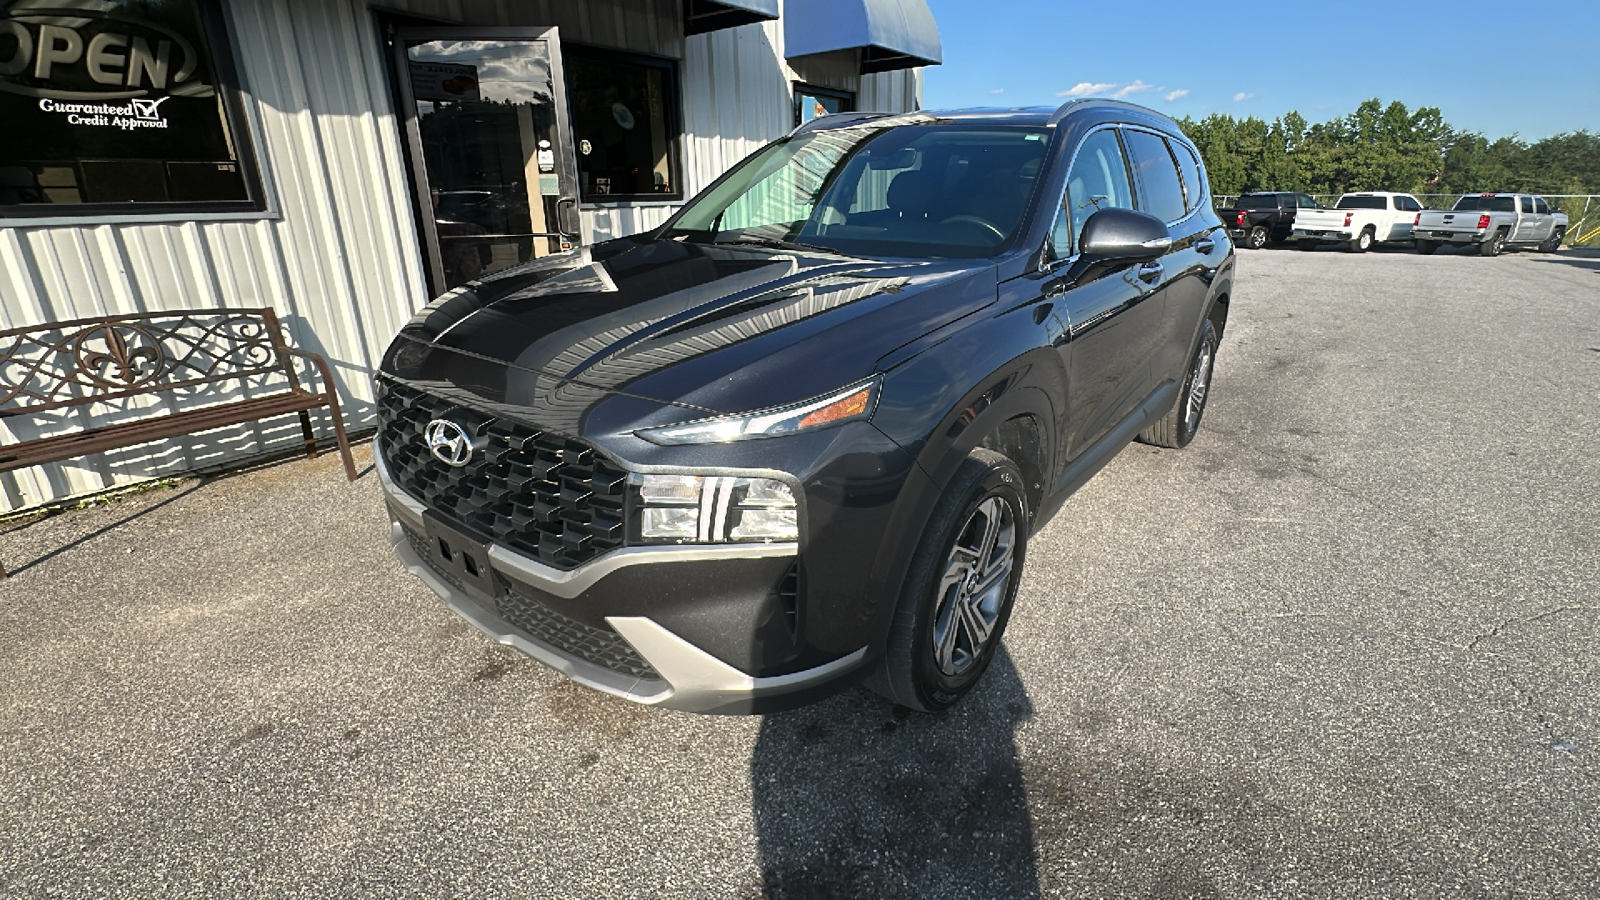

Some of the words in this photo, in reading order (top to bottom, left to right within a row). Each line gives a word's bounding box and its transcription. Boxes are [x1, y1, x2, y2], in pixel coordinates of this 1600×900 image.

[0, 19, 171, 89] OPEN
[39, 98, 134, 116] Guaranteed
[67, 113, 109, 127] Credit
[111, 116, 168, 130] Approval
